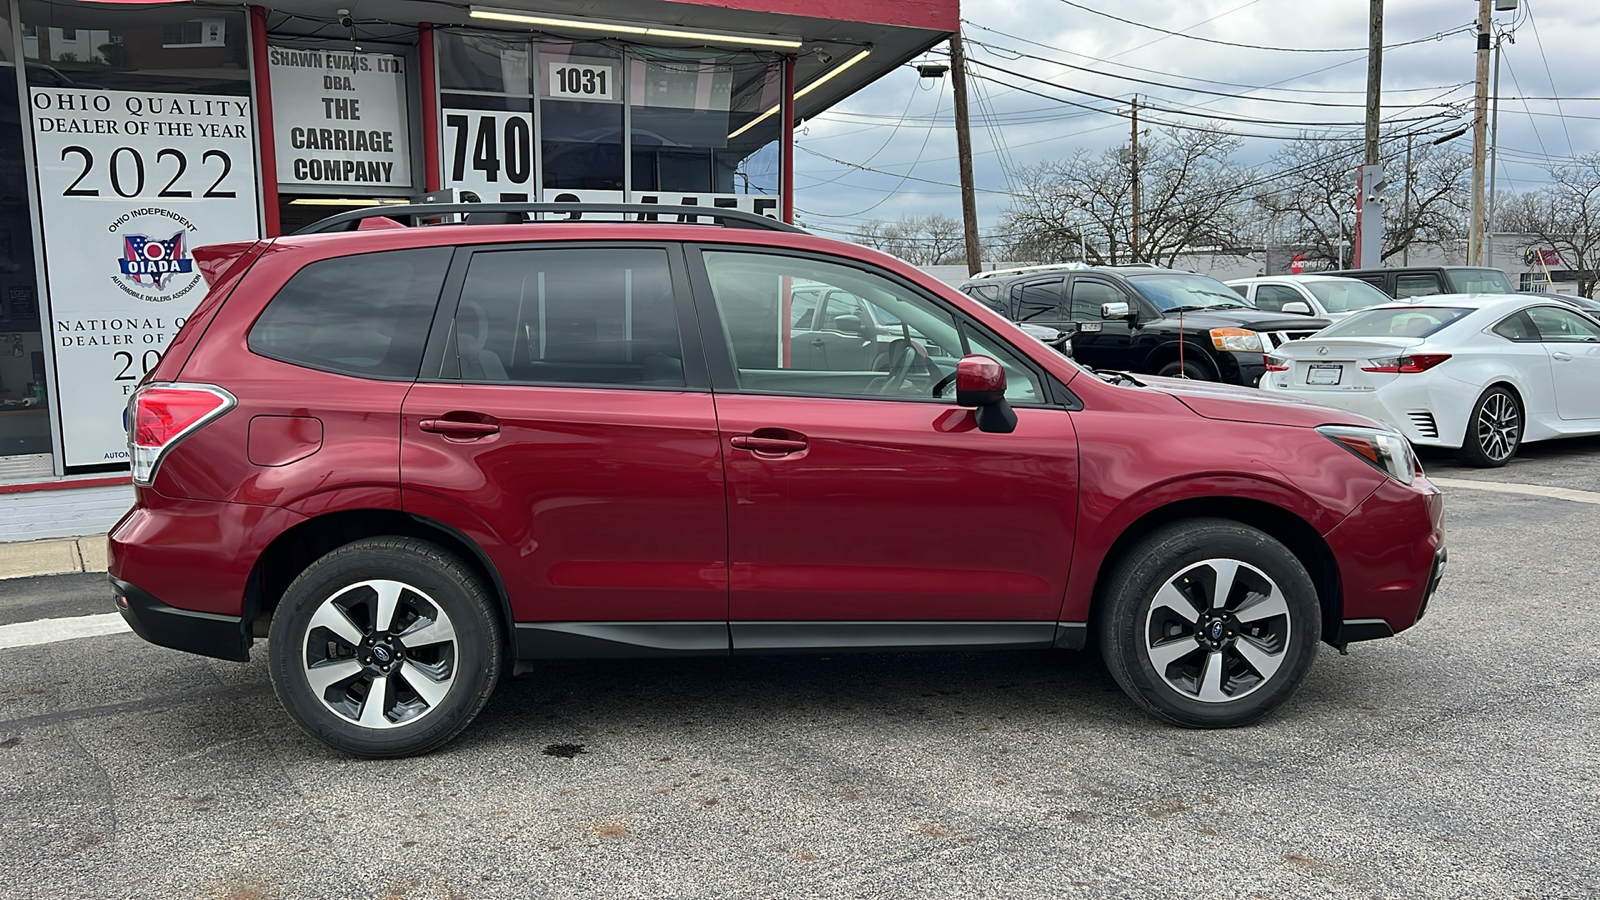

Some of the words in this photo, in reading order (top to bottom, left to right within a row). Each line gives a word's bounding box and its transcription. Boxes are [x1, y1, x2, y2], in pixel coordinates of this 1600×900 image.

[271, 51, 322, 68] SHAWN
[377, 58, 403, 74] LTD.
[323, 76, 355, 91] DBA.
[556, 67, 607, 95] 1031
[33, 92, 111, 112] OHIO
[125, 96, 248, 117] QUALITY
[322, 98, 360, 120] THE
[38, 117, 119, 135] DEALER
[124, 120, 149, 136] OF
[154, 121, 194, 137] THE
[197, 123, 248, 139] YEAR
[291, 127, 393, 153] CARRIAGE
[447, 114, 531, 184] 740
[60, 145, 237, 198] 2022
[294, 159, 393, 183] COMPANY
[108, 213, 130, 233] OHIO
[130, 207, 198, 233] INDEPENDENT
[128, 260, 180, 273] OIADA
[111, 275, 144, 300] AUTOMOBILE
[145, 294, 172, 302] DEALERS
[172, 273, 202, 300] ASSOCIATION
[57, 318, 166, 332] NATIONAL
[61, 334, 134, 346] DEALER
[142, 333, 164, 344] OF
[113, 349, 161, 381] 20
